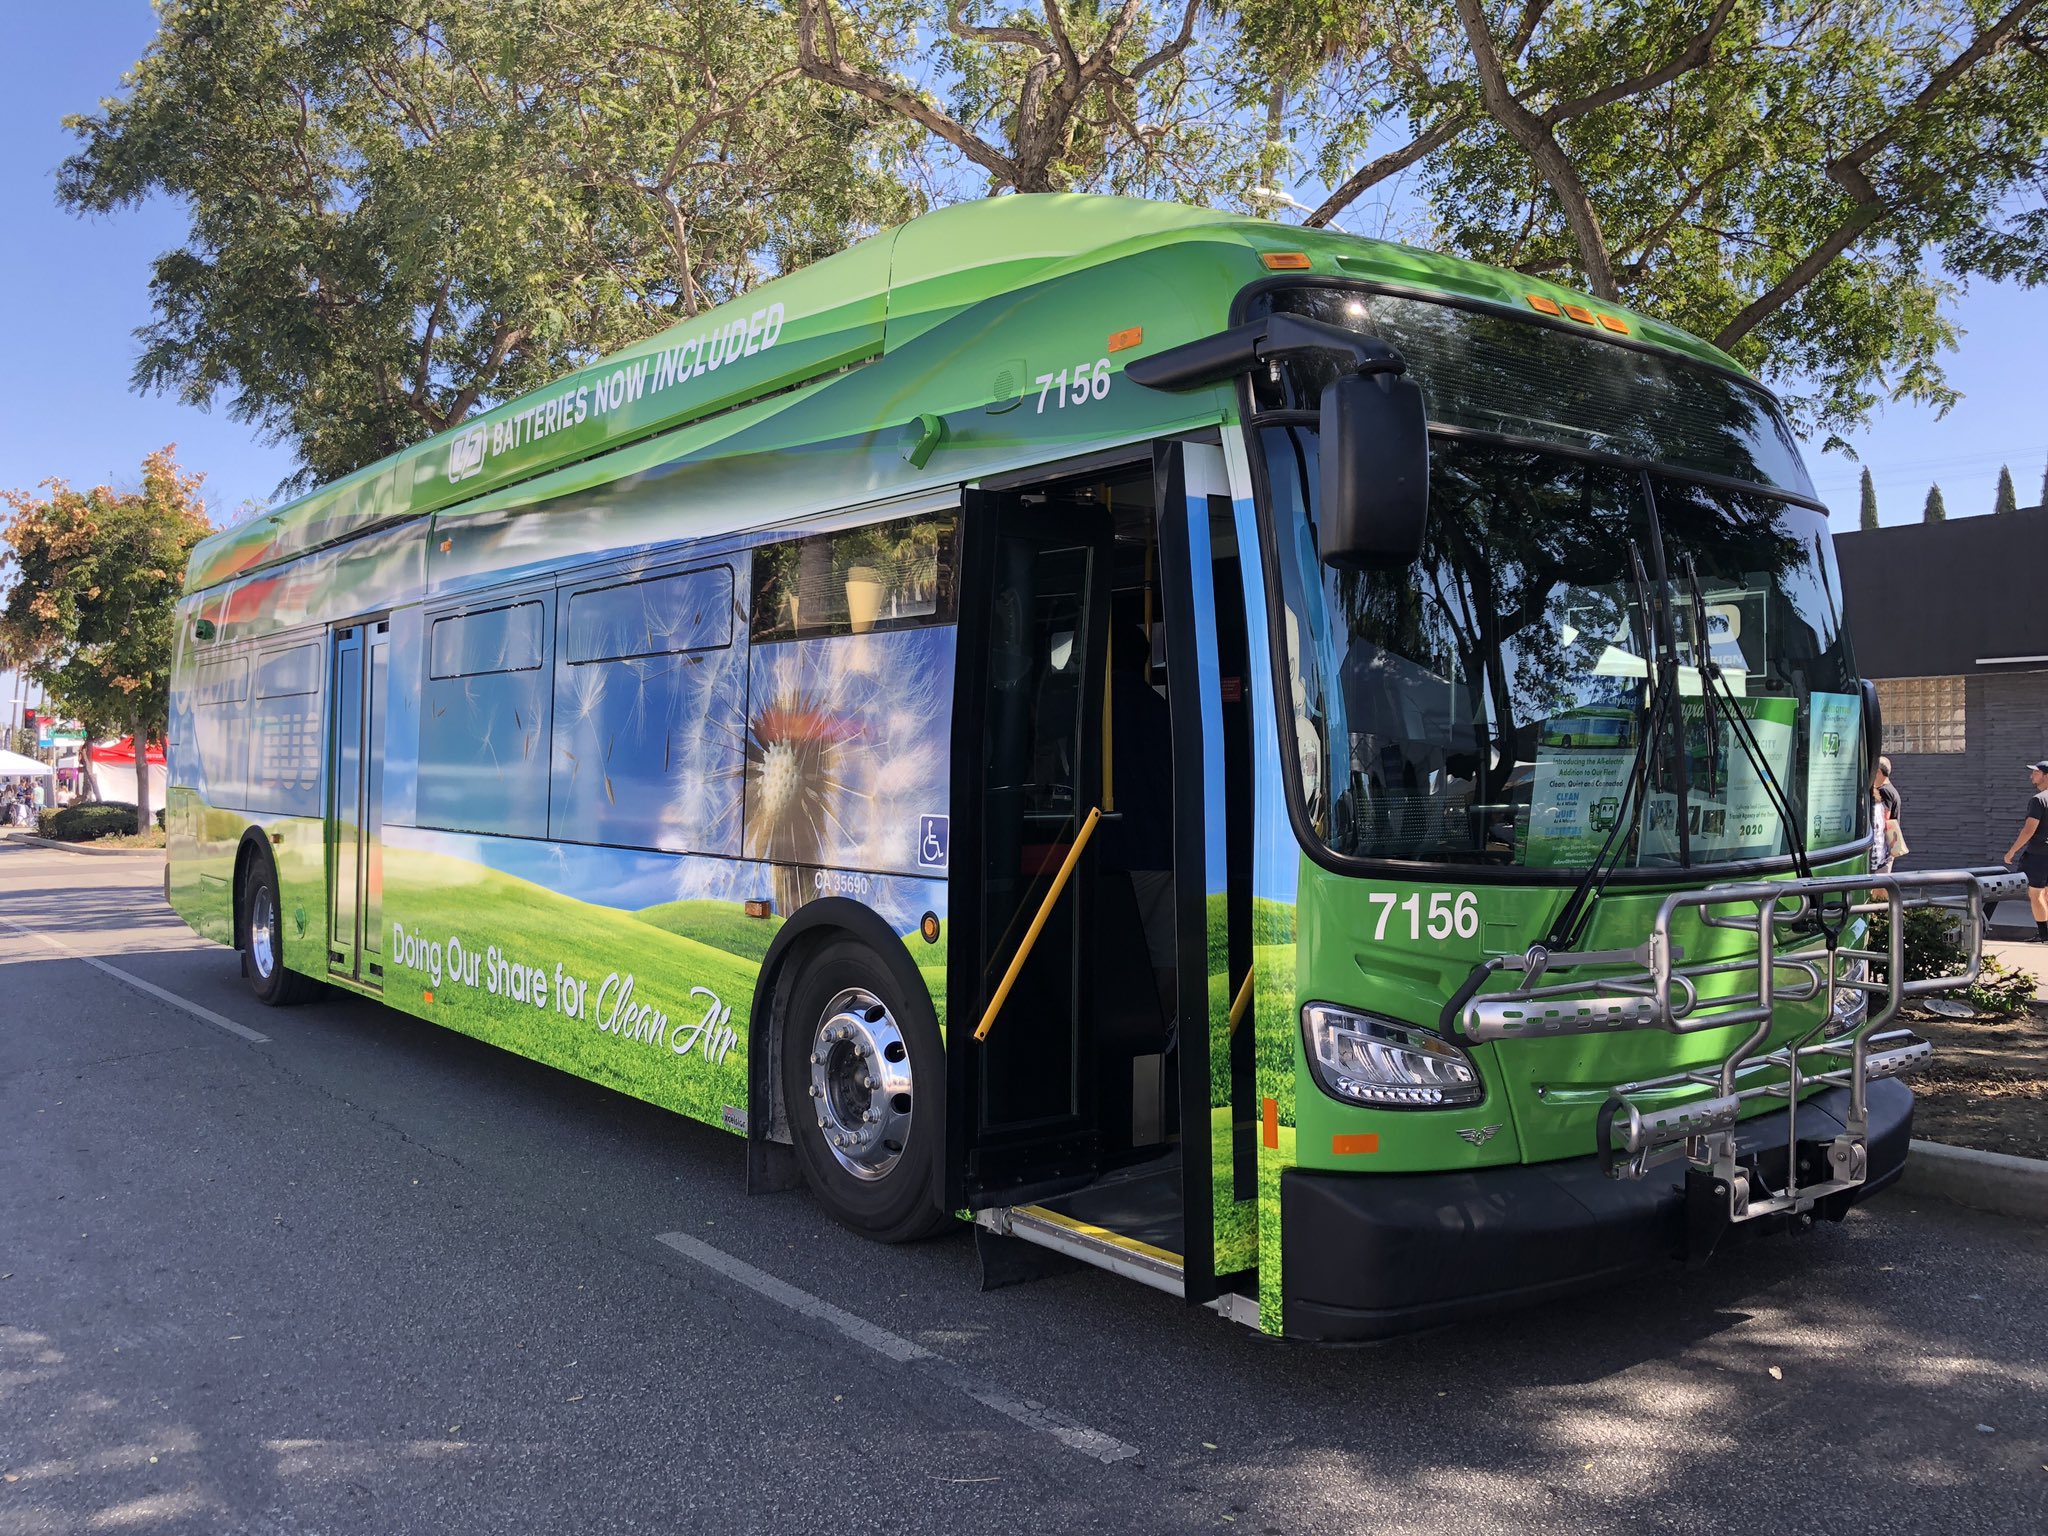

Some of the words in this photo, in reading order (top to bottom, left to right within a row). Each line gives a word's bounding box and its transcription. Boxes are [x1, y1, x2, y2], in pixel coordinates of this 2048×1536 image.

[492, 385, 588, 458] BATTERIES
[593, 358, 649, 417] NOW
[650, 302, 784, 395] INCLUDED
[1035, 358, 1111, 414] 7156
[1553, 757, 1586, 766] Introducing
[1587, 757, 1596, 765] the
[1591, 768, 1602, 777] Our
[1603, 768, 1617, 776] Fleet
[1556, 792, 1579, 801] CLEAN
[1555, 809, 1577, 818] QUIET
[1739, 824, 1763, 836] 2020
[814, 870, 831, 890] CA
[834, 873, 868, 895] 35690
[1368, 891, 1479, 941] 7156
[393, 922, 442, 988] Doing
[447, 936, 482, 988] Our
[487, 945, 548, 1009] Share
[555, 962, 587, 1020] for
[595, 971, 668, 1047] Clean
[671, 986, 738, 1066] Air
